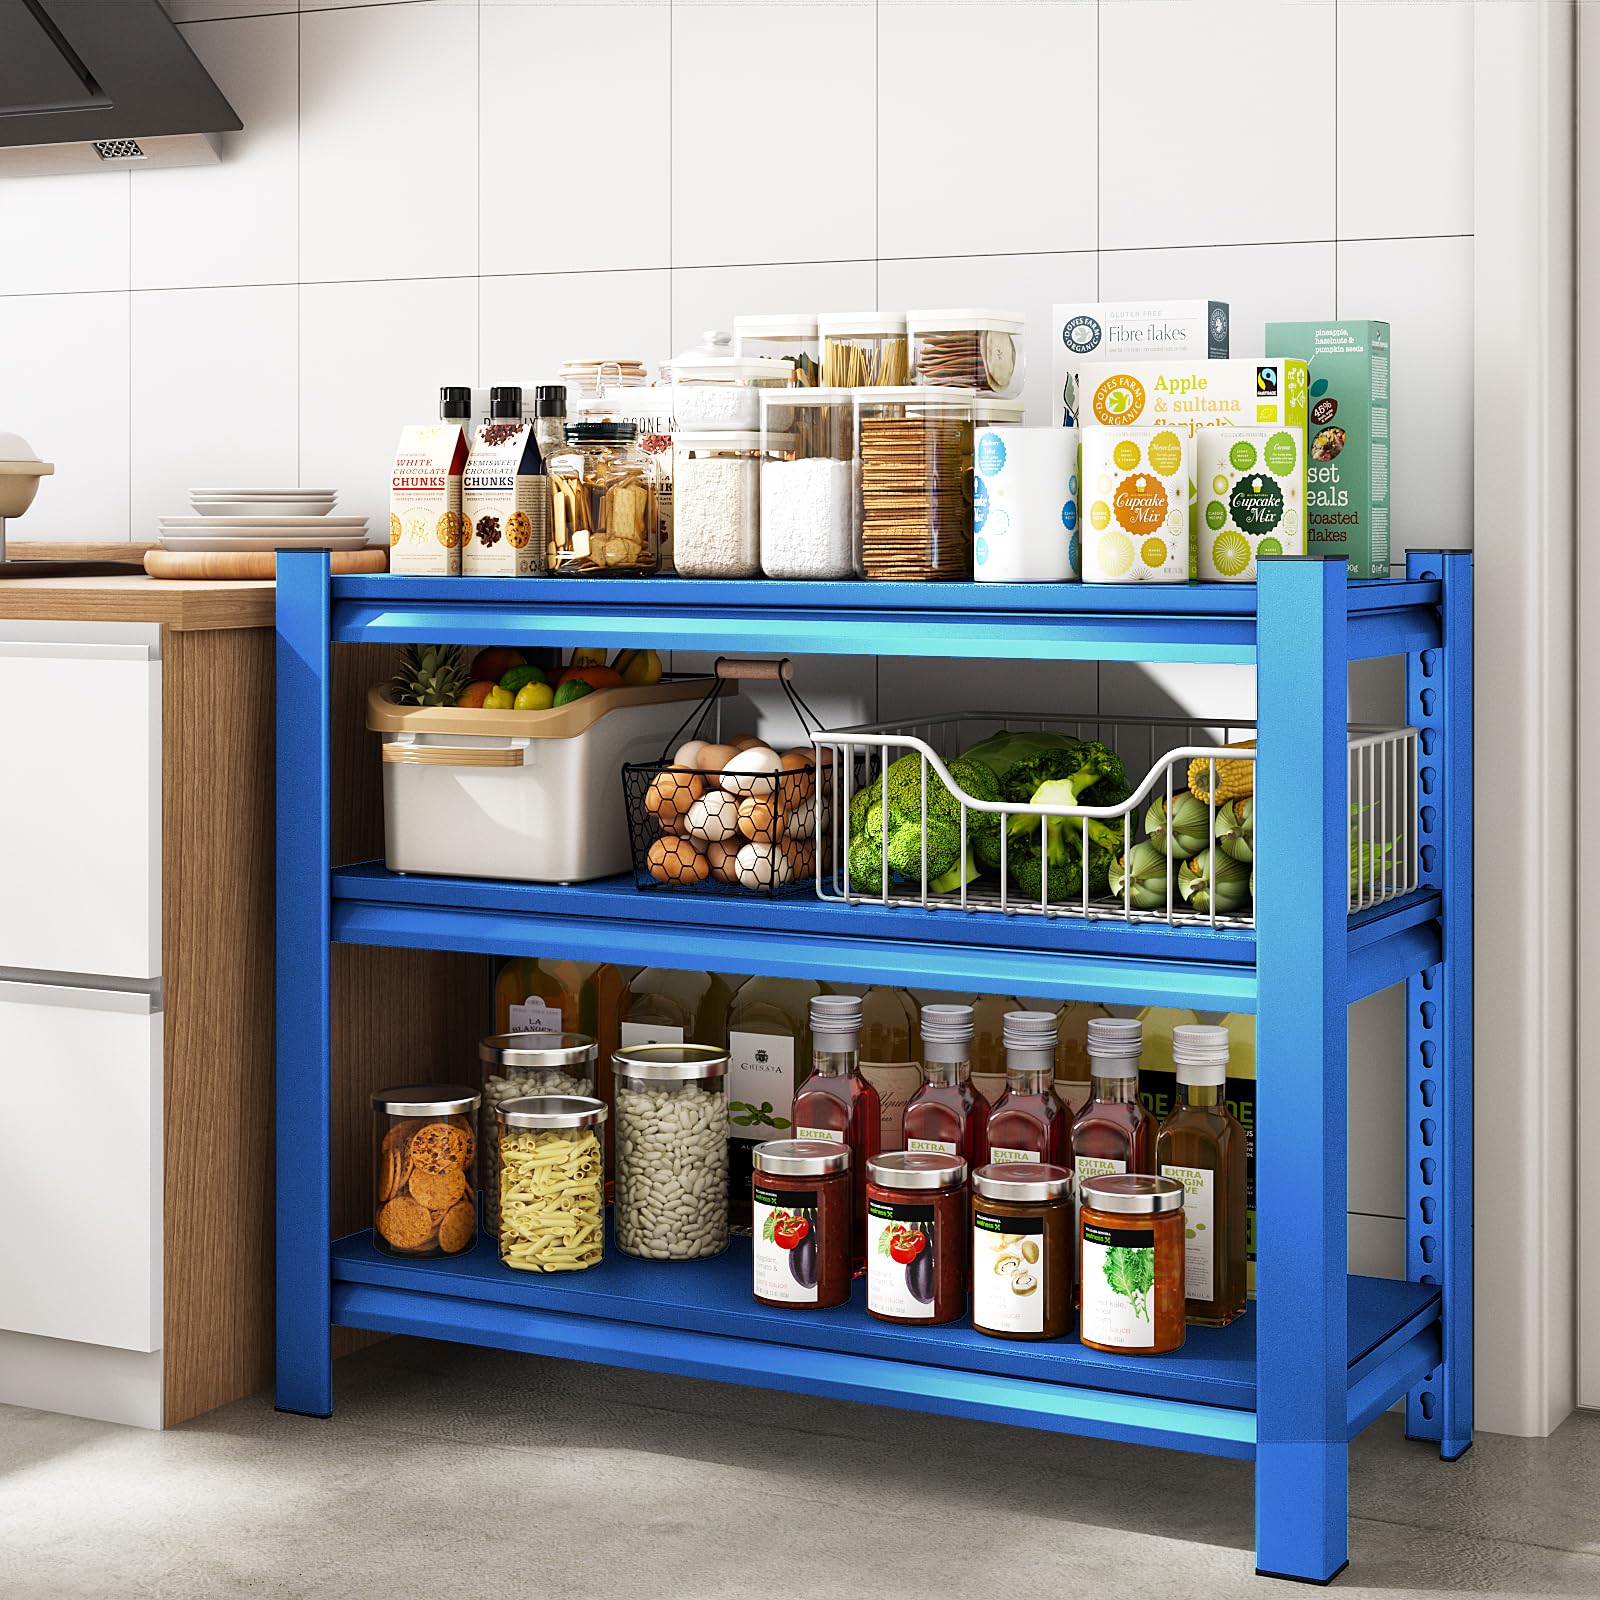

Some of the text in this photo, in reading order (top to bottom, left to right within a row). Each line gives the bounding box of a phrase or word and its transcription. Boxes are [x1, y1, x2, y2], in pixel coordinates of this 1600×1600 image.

[1064, 317, 1100, 338] DOVES FARM
[1109, 323, 1187, 342] Fibre flakes
[1315, 328, 1349, 338] pineapple,
[1066, 337, 1099, 352] ORGANIC
[1315, 346, 1345, 354] pumpkin
[1154, 375, 1208, 395] Apple
[1095, 377, 1141, 410] DOVES FARM
[1154, 396, 1241, 412] & sultana
[1314, 401, 1333, 417] 45%
[1101, 402, 1142, 425] ORGANIC
[396, 459, 433, 467] WHITE
[467, 459, 518, 467] SEMISWEET
[392, 477, 446, 487] CHUNKS
[463, 477, 514, 487] CHUNKS
[1116, 492, 1165, 511] Cupcake
[1232, 492, 1281, 511] Cupcake
[1129, 508, 1160, 523] Mix
[1246, 508, 1276, 523] Mix
[1309, 511, 1359, 525] toasted
[1308, 528, 1347, 542] flakes
[529, 1018, 541, 1026] LA
[741, 1062, 783, 1074] CHINATA
[799, 1129, 833, 1140] EXTRA
[911, 1141, 945, 1152] EXTRA
[993, 1150, 1029, 1161] EXTRA
[1078, 1158, 1115, 1170] EXTRA
[1164, 1167, 1202, 1179] EXTRA
